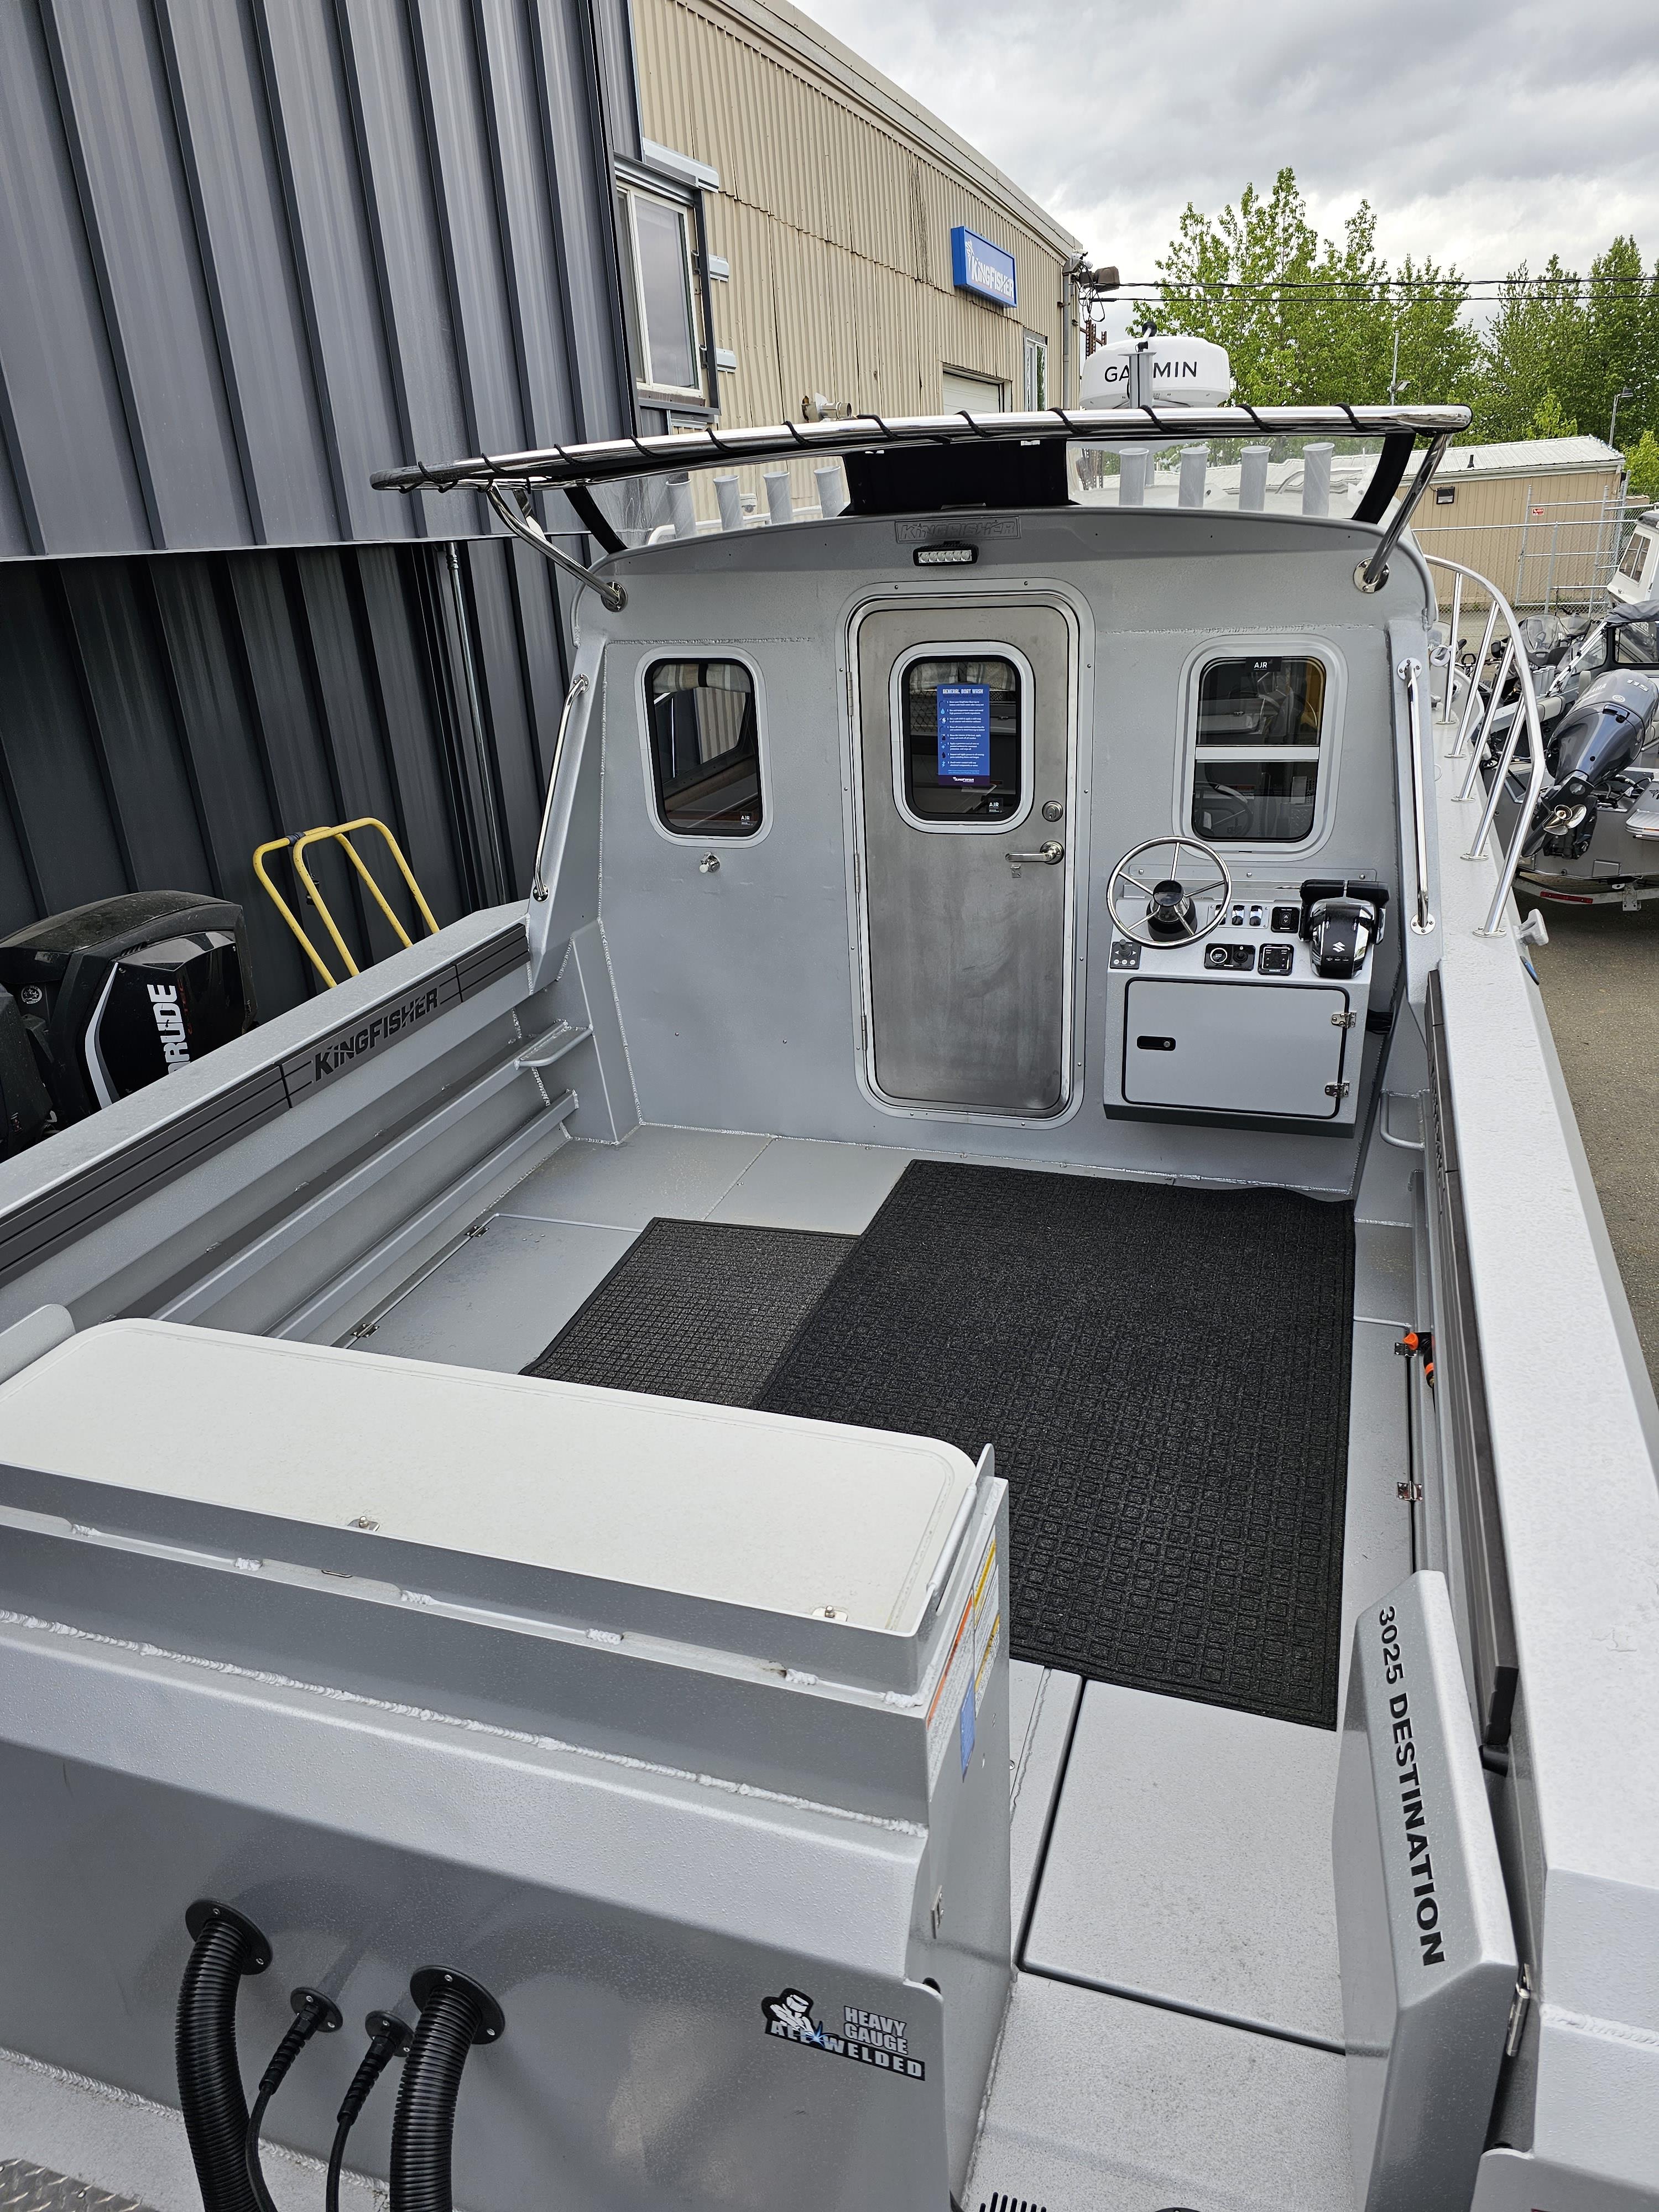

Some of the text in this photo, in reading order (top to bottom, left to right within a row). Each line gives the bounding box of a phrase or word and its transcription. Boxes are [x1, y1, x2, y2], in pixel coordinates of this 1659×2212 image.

[971, 255, 1014, 299] KINGFISHER
[1105, 361, 1197, 382] GAMIN
[900, 521, 1016, 540] KINGFISHER
[1626, 679, 1650, 692] 115
[315, 987, 438, 1082] KINGFISHER
[1379, 1605, 1445, 1966] 3025 DESTINATION
[844, 2006, 907, 2037] HEAVY
[844, 2022, 908, 2054] GAUGE
[823, 2035, 922, 2078] WELDED
